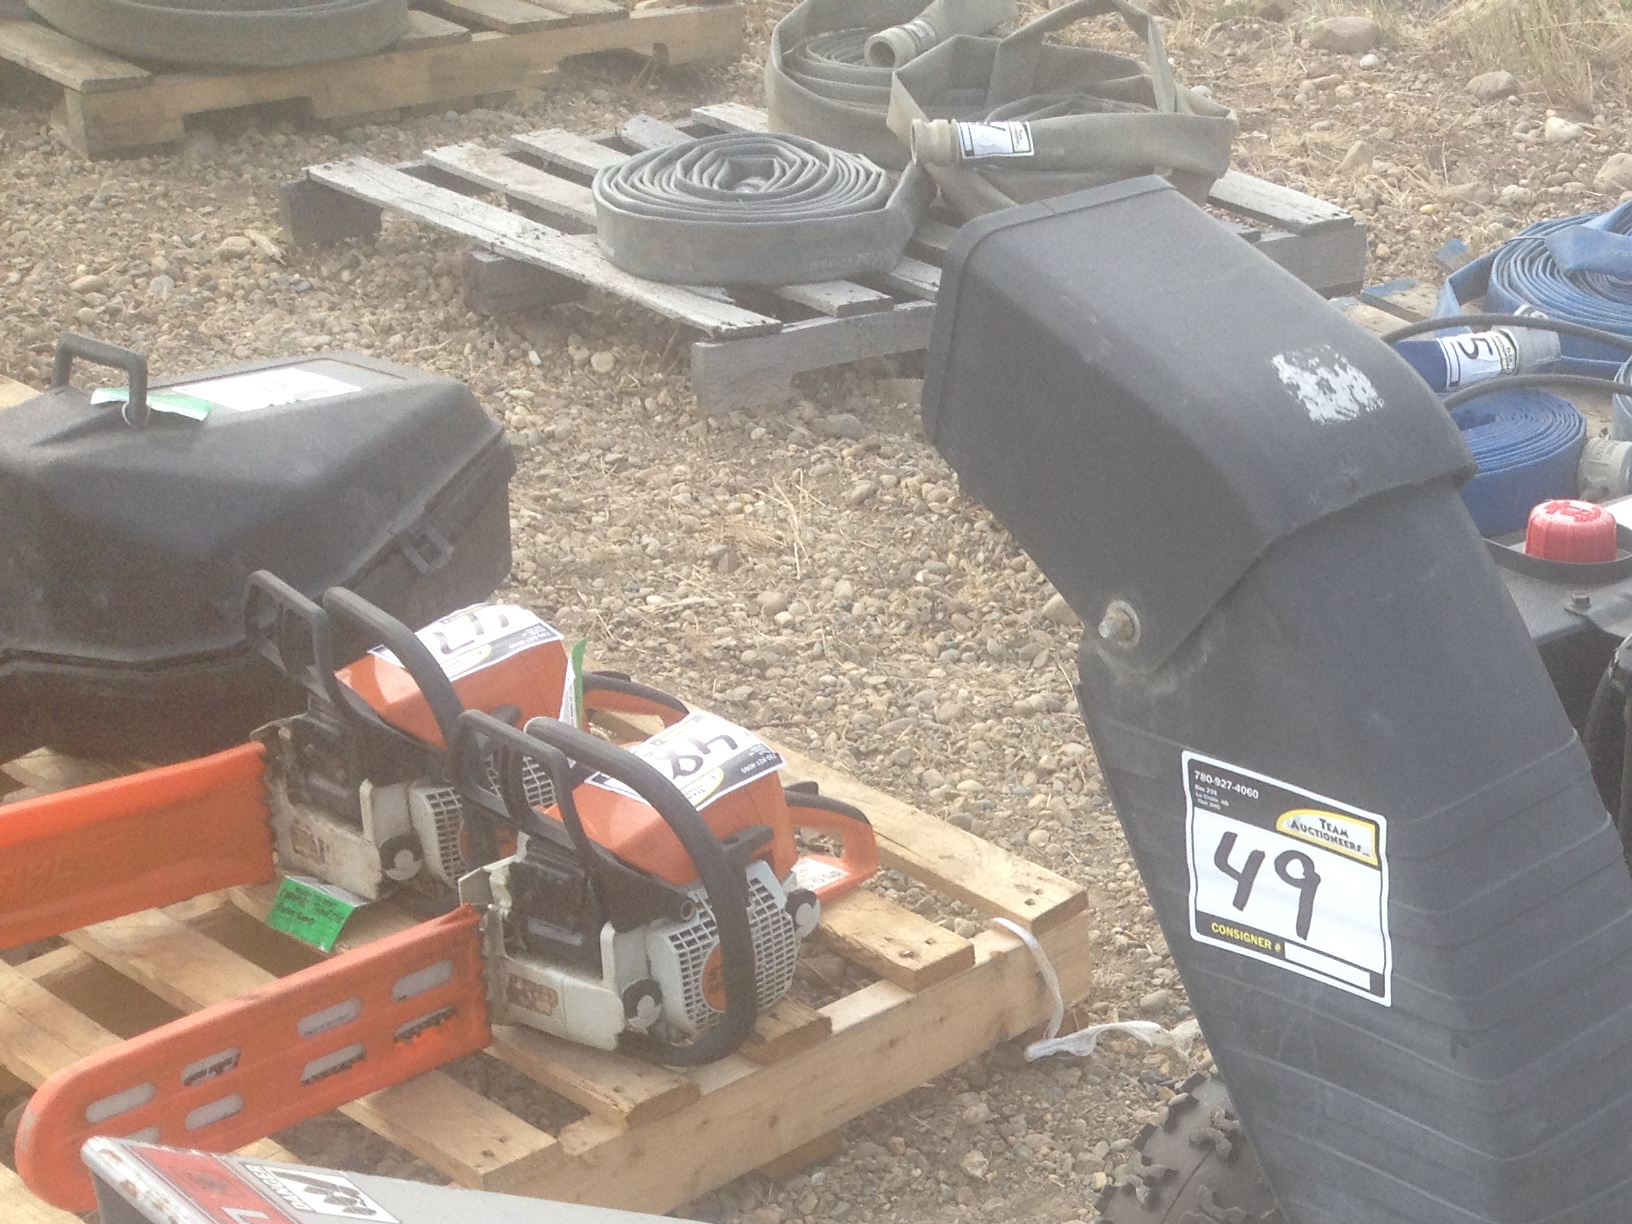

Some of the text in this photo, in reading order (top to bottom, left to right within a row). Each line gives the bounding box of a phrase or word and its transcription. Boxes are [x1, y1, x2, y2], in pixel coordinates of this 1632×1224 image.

[1194, 771, 1259, 799] 780-927-4060
[1290, 819, 1362, 853] AUCTIONEERS
[1319, 817, 1349, 838] TEAM
[1214, 831, 1321, 940] 49
[1211, 922, 1272, 951] CONSIGNER
